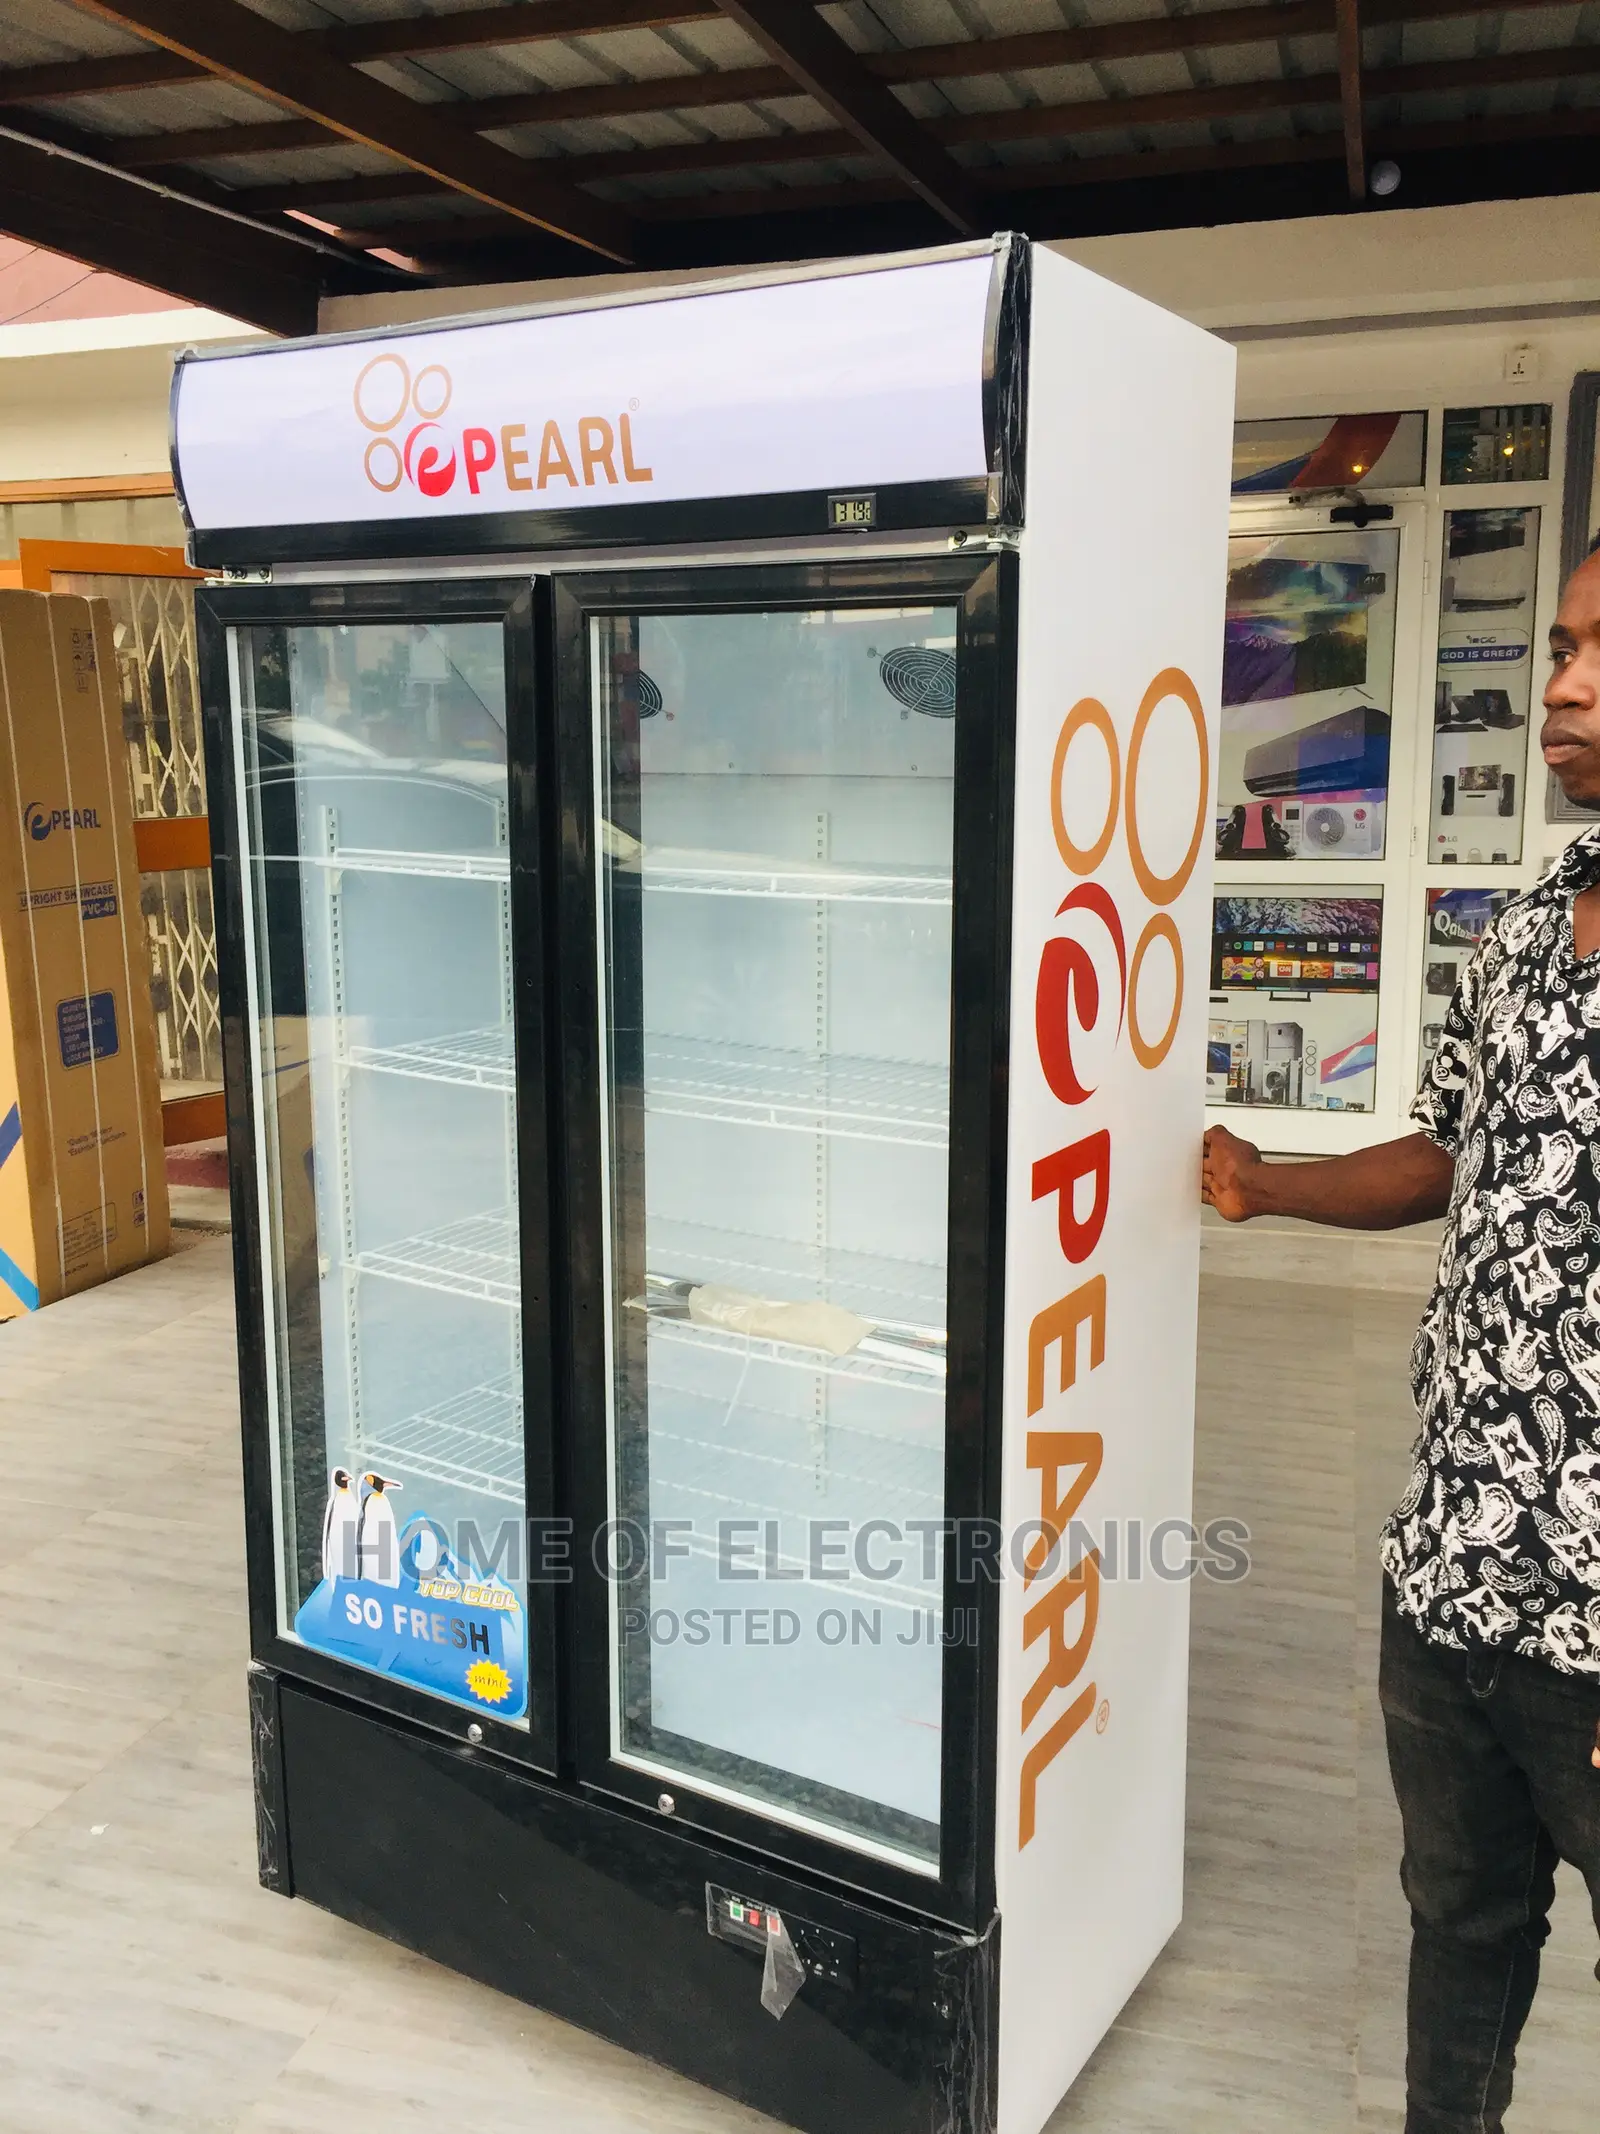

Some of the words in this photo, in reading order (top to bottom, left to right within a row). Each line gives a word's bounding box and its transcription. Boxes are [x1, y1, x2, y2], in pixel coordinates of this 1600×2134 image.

[1441, 651, 1464, 659] GOD
[1468, 650, 1479, 658] IS
[1482, 648, 1520, 658] GREAT
[1447, 835, 1458, 843] LG
[65, 884, 114, 902] SHWCASE
[420, 1577, 461, 1600] TOP
[462, 1585, 519, 1611] COOL
[345, 1593, 383, 1630] SO
[392, 1603, 490, 1655] FRESH
[474, 1674, 504, 1690] mini
